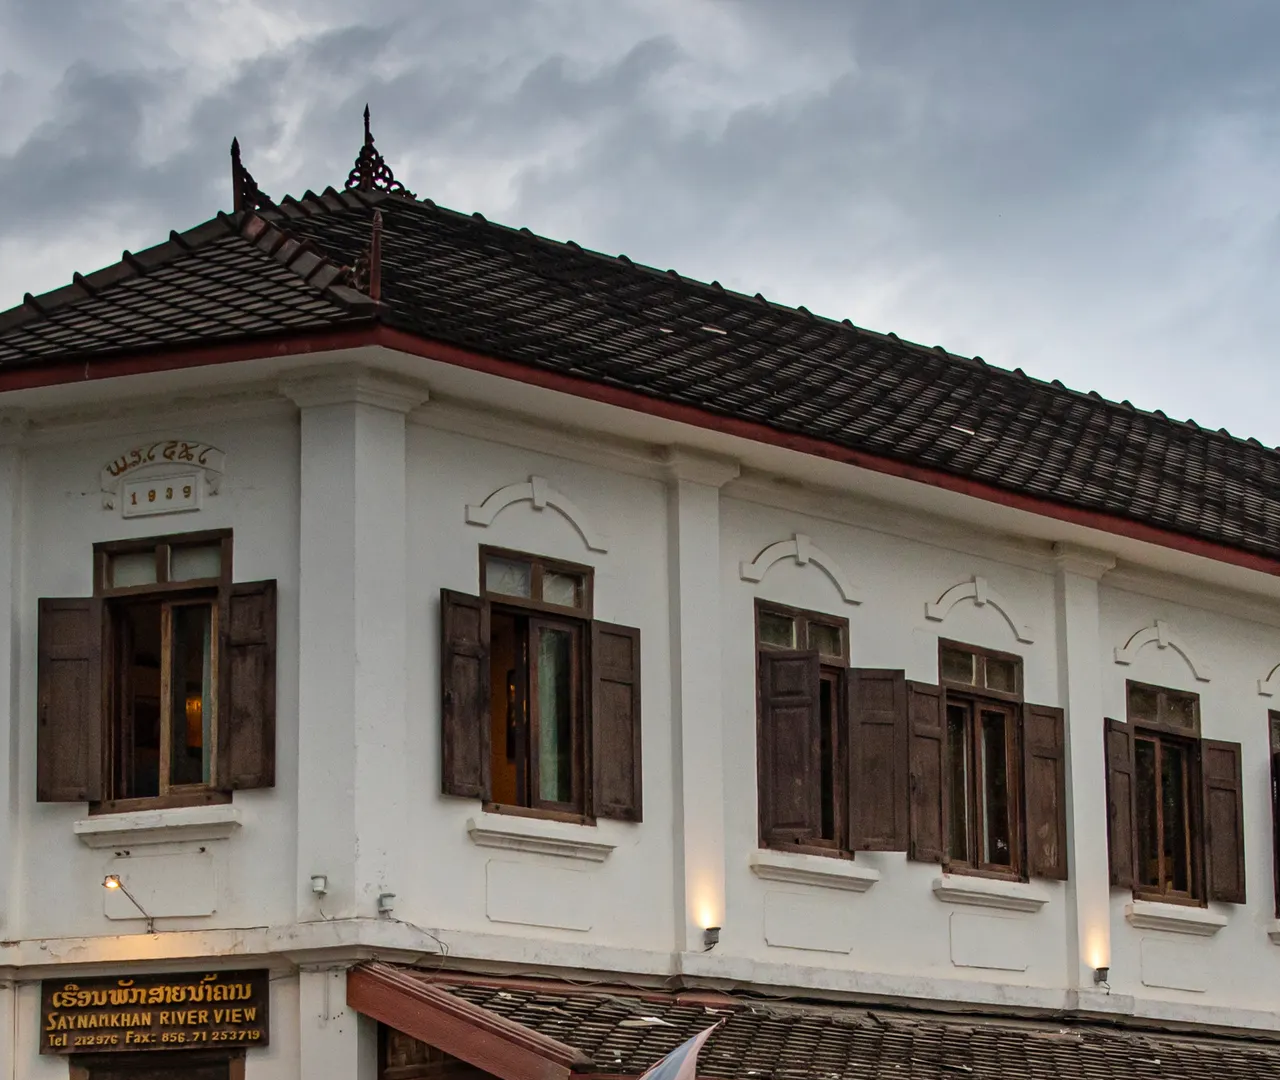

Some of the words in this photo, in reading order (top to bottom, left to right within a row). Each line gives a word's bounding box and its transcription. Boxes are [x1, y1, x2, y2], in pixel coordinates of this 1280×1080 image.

[131, 485, 192, 505] 1939
[46, 1012, 151, 1031] SAYNAMKHAN
[160, 1010, 208, 1025] RIVER
[213, 1007, 257, 1024] VIEW
[48, 1033, 67, 1046] Tel
[74, 1034, 118, 1046] 212976
[125, 1030, 156, 1044] Fax:
[212, 1030, 260, 1041] 253719
